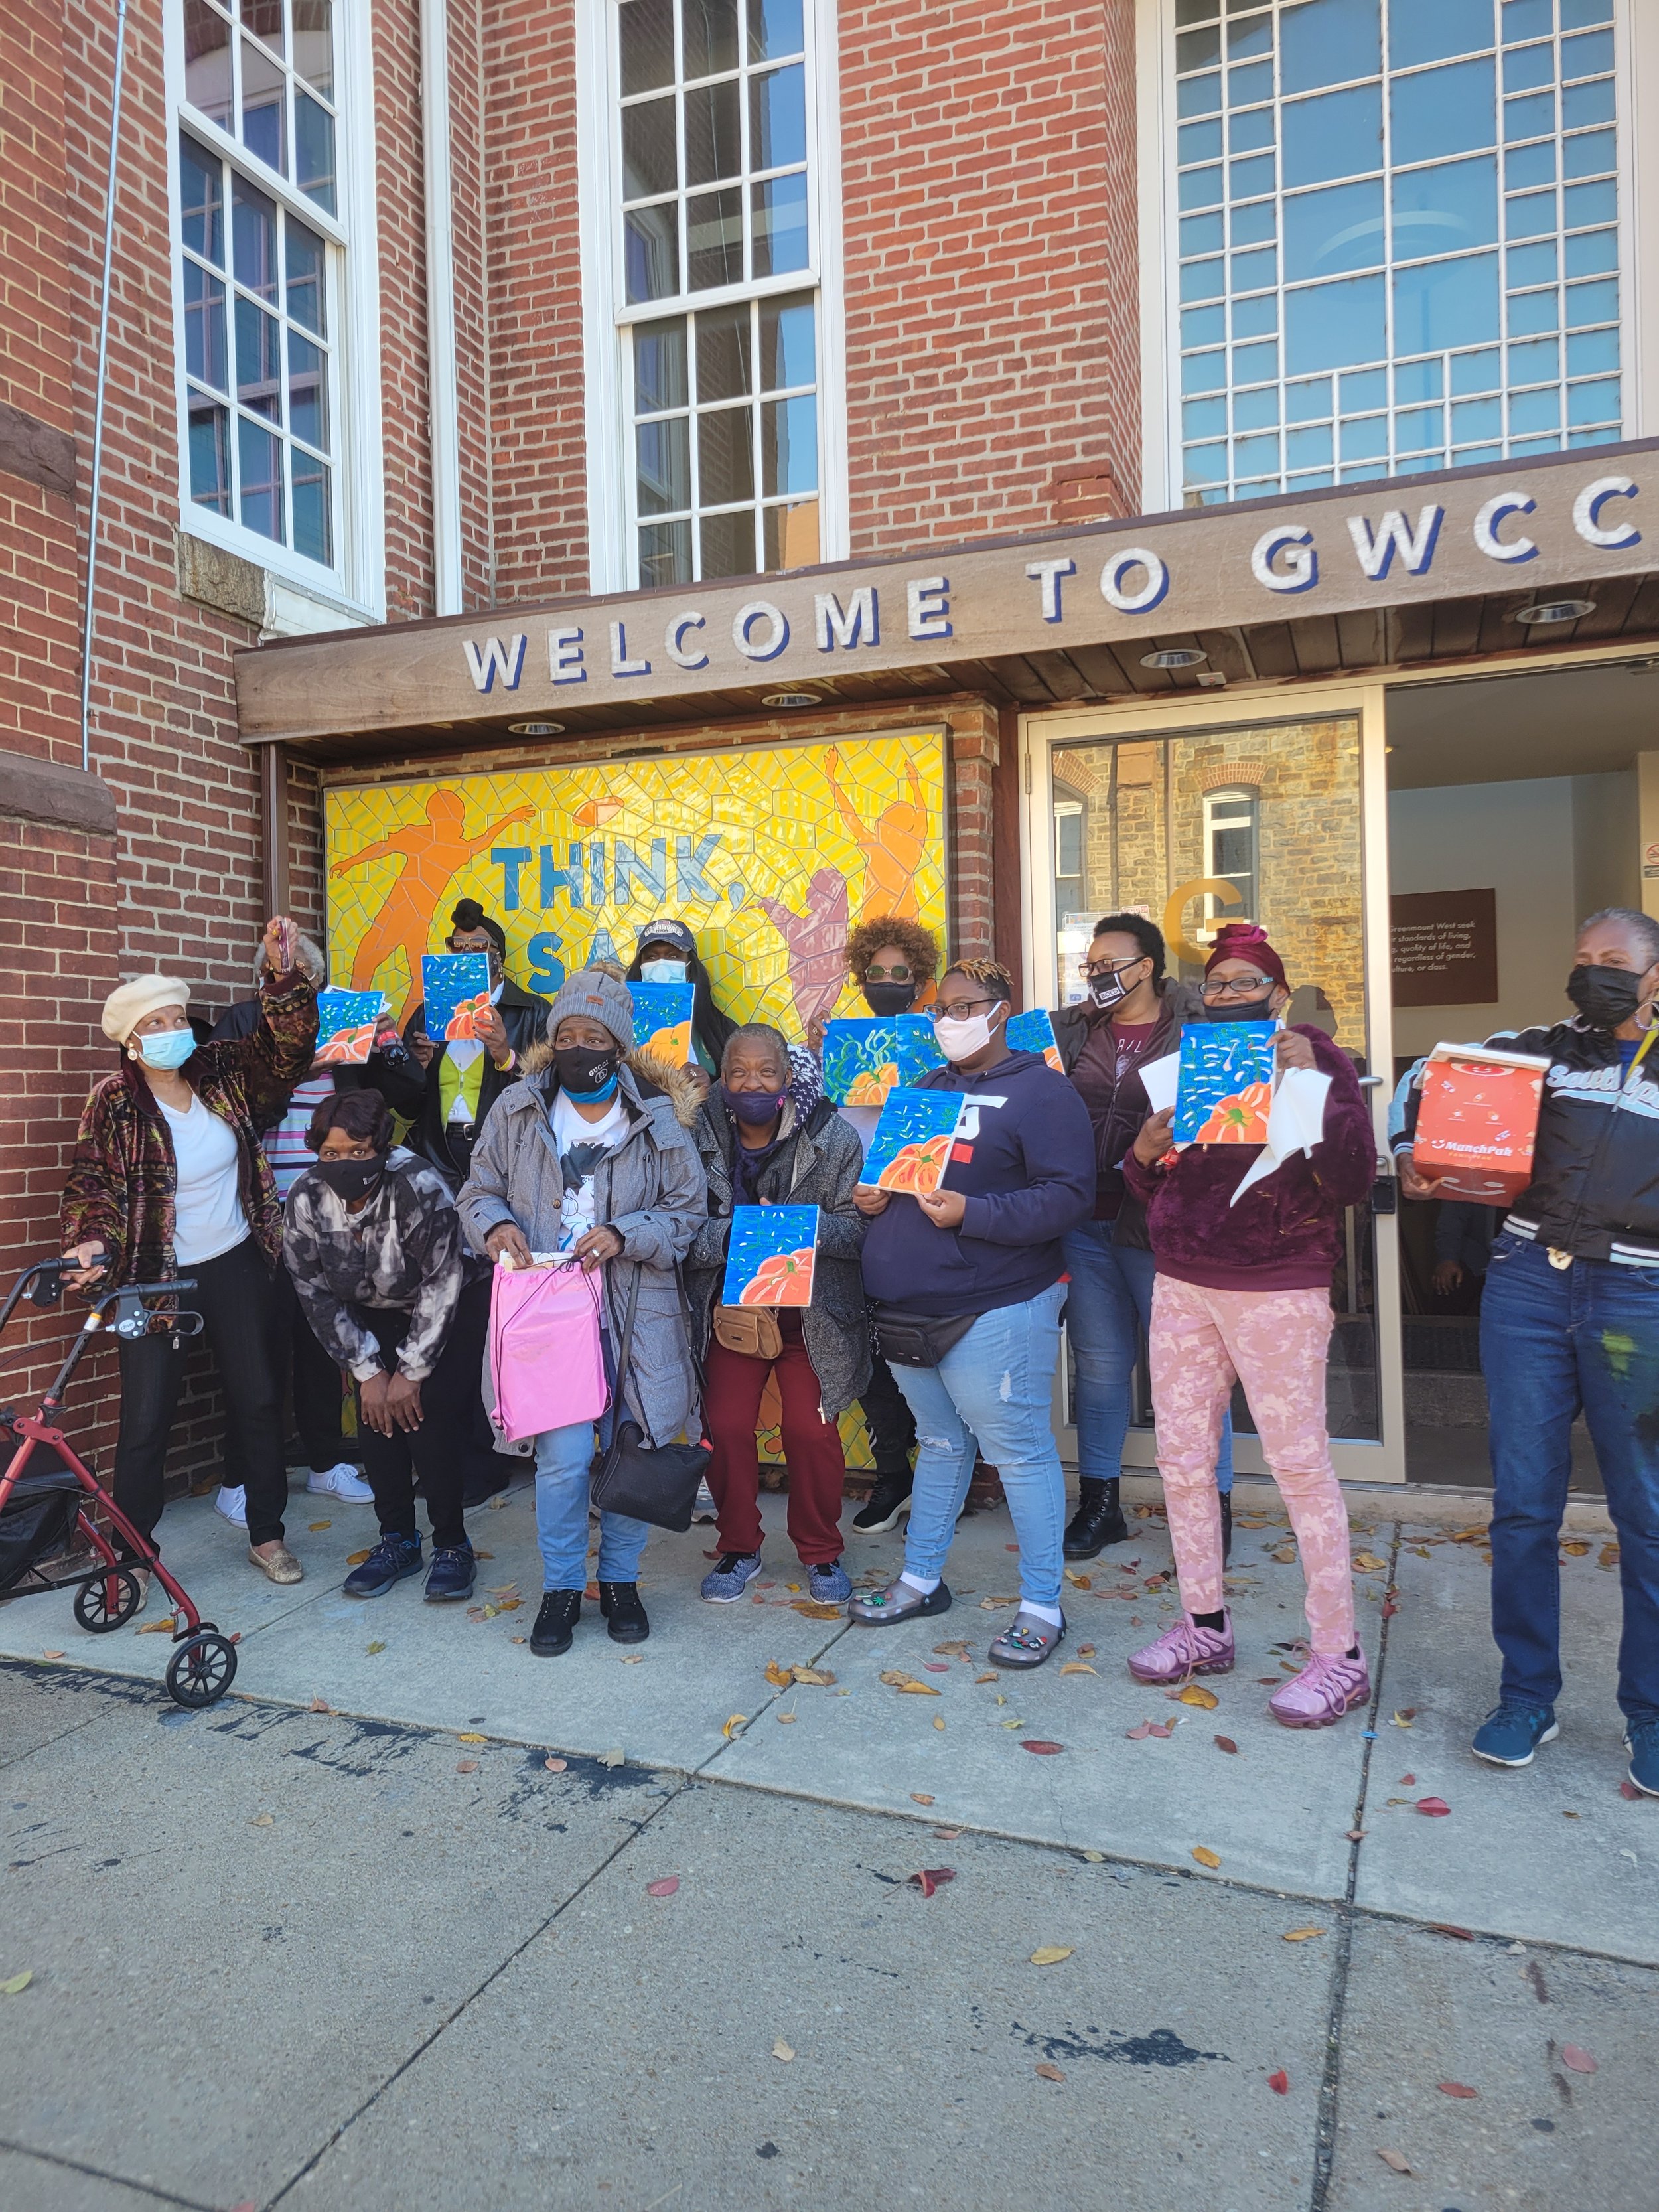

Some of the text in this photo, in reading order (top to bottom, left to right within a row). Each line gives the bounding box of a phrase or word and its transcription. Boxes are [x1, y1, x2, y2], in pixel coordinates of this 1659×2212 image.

[461, 475, 1644, 694] WELCOME TO GWCC
[490, 833, 745, 912] THINK,
[1398, 933, 1435, 942] standards
[1400, 944, 1427, 954] quality
[1394, 954, 1433, 964] regardless
[1446, 951, 1476, 961] gender,
[1101, 989, 1118, 999] BOLD
[589, 1059, 609, 1077] GUCCI
[1445, 1142, 1513, 1157] MunchPak
